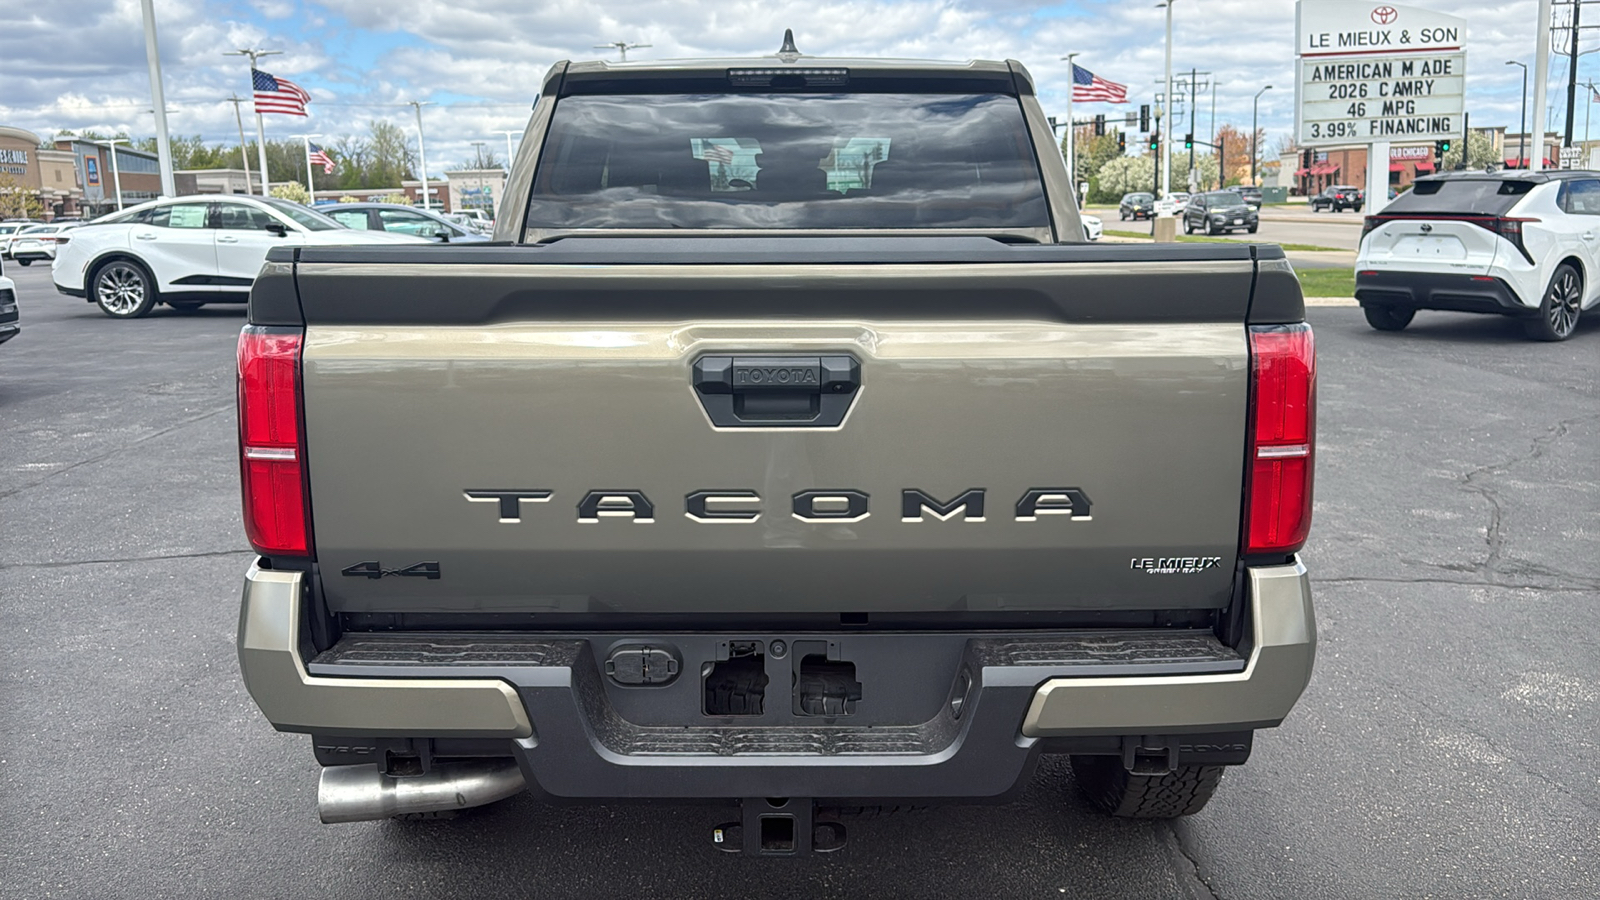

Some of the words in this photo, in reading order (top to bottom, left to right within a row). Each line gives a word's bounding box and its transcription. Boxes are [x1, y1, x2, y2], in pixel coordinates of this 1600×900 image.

[1309, 33, 1330, 48] LE
[1338, 30, 1392, 47] MIEUX
[1399, 29, 1411, 44] &
[1420, 27, 1458, 43] SON
[1312, 62, 1392, 81] AMERICAN
[1401, 59, 1452, 77] MADE
[1329, 83, 1368, 99] 2026
[1379, 79, 1435, 97] CAMRY
[1347, 102, 1366, 117] 46
[1382, 100, 1415, 116] MPG
[1311, 121, 1357, 138] 3.99%
[1370, 117, 1451, 135] FINANCING
[737, 368, 817, 383] TOYOTA
[462, 487, 1094, 524] TACOMA
[1130, 558, 1154, 569] LE
[1158, 556, 1222, 569] MIEUX
[317, 745, 377, 754] TAC
[1179, 743, 1247, 753] COMA
